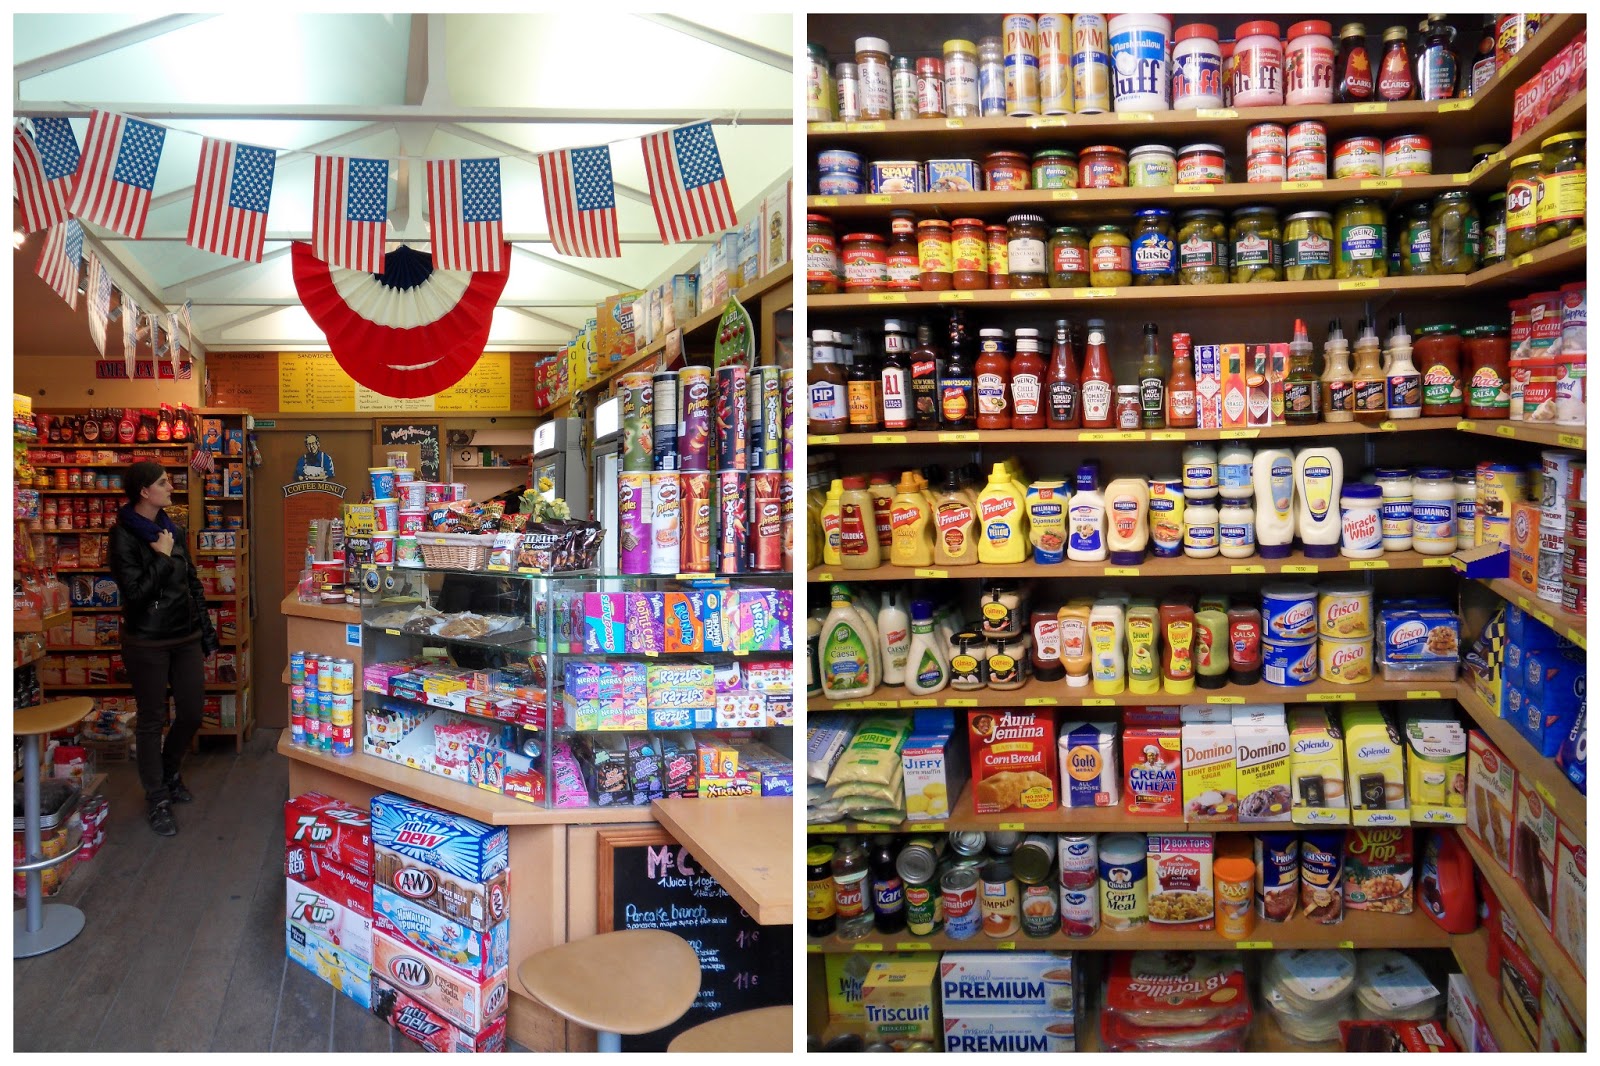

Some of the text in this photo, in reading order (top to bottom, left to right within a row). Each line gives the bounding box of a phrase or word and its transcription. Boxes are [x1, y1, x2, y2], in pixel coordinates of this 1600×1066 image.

[1007, 32, 1035, 52] PAM
[1076, 29, 1104, 50] PAM
[1347, 76, 1371, 88] CLARKS
[1543, 63, 1565, 90] JELL-O
[1381, 80, 1410, 89] CLARKS
[1516, 86, 1538, 114] JELL-O
[882, 168, 911, 177] SPAM
[934, 163, 965, 172] SPAM
[814, 389, 832, 400] HP
[1427, 387, 1449, 396] SALSA
[1473, 389, 1495, 398] SALSA
[693, 410, 707, 418] BBQ
[287, 483, 341, 493] COFFEE MENU
[984, 500, 1011, 513] French's
[1032, 505, 1061, 513] HELLMANN'S
[893, 510, 918, 521] French's
[941, 513, 969, 525] French's
[1414, 509, 1449, 517] HELLMANN'S
[1344, 514, 1376, 530] Miracle
[1350, 526, 1375, 539] Whip
[985, 606, 1005, 615] Colman's
[1288, 606, 1312, 623] Crisco
[1328, 601, 1359, 620] Crisco
[1393, 627, 1422, 643] Crisco
[831, 649, 858, 658] Caesar
[1333, 646, 1364, 666] Crisco
[954, 659, 976, 667] Colman's
[992, 659, 1012, 667] Colman's
[1000, 711, 1036, 726] Aunt
[858, 735, 892, 743] PURITY
[984, 725, 1044, 743] Jemima
[1240, 742, 1286, 760] Domino
[1298, 740, 1331, 752] Splenda
[985, 752, 1041, 765] Corn Bread
[1185, 746, 1233, 763] Domino
[1359, 747, 1391, 758] Splenda
[905, 758, 941, 769] JIFFY
[1072, 754, 1095, 768] Gold
[1130, 768, 1176, 780] CREAM
[1187, 763, 1232, 777] LIGHT BROWN
[1241, 760, 1285, 776] DARK BROWN
[1255, 770, 1275, 778] SUGAR
[1201, 771, 1221, 780] SUGAR
[1132, 781, 1176, 791] WHEAT
[1368, 813, 1396, 823] Splenda
[294, 816, 332, 841] 7 UP
[399, 822, 429, 833] Mtn
[362, 835, 369, 844] 12
[1163, 839, 1189, 851] 2 BOX
[289, 849, 303, 861] BIG
[288, 860, 305, 874] RED
[1166, 866, 1198, 876] Helper
[401, 872, 431, 892] A&W
[1109, 880, 1132, 889] QUAKER
[453, 894, 467, 903] BEER
[1106, 891, 1135, 903] Corn
[292, 893, 334, 923] 7 UP
[1106, 901, 1136, 911] Meal
[626, 903, 707, 922] Pancake brunch
[398, 963, 424, 983] A&W
[944, 982, 1045, 999] PREMIUM
[865, 1004, 930, 1022] Triscuit
[948, 1034, 1048, 1052] PREMIUM
